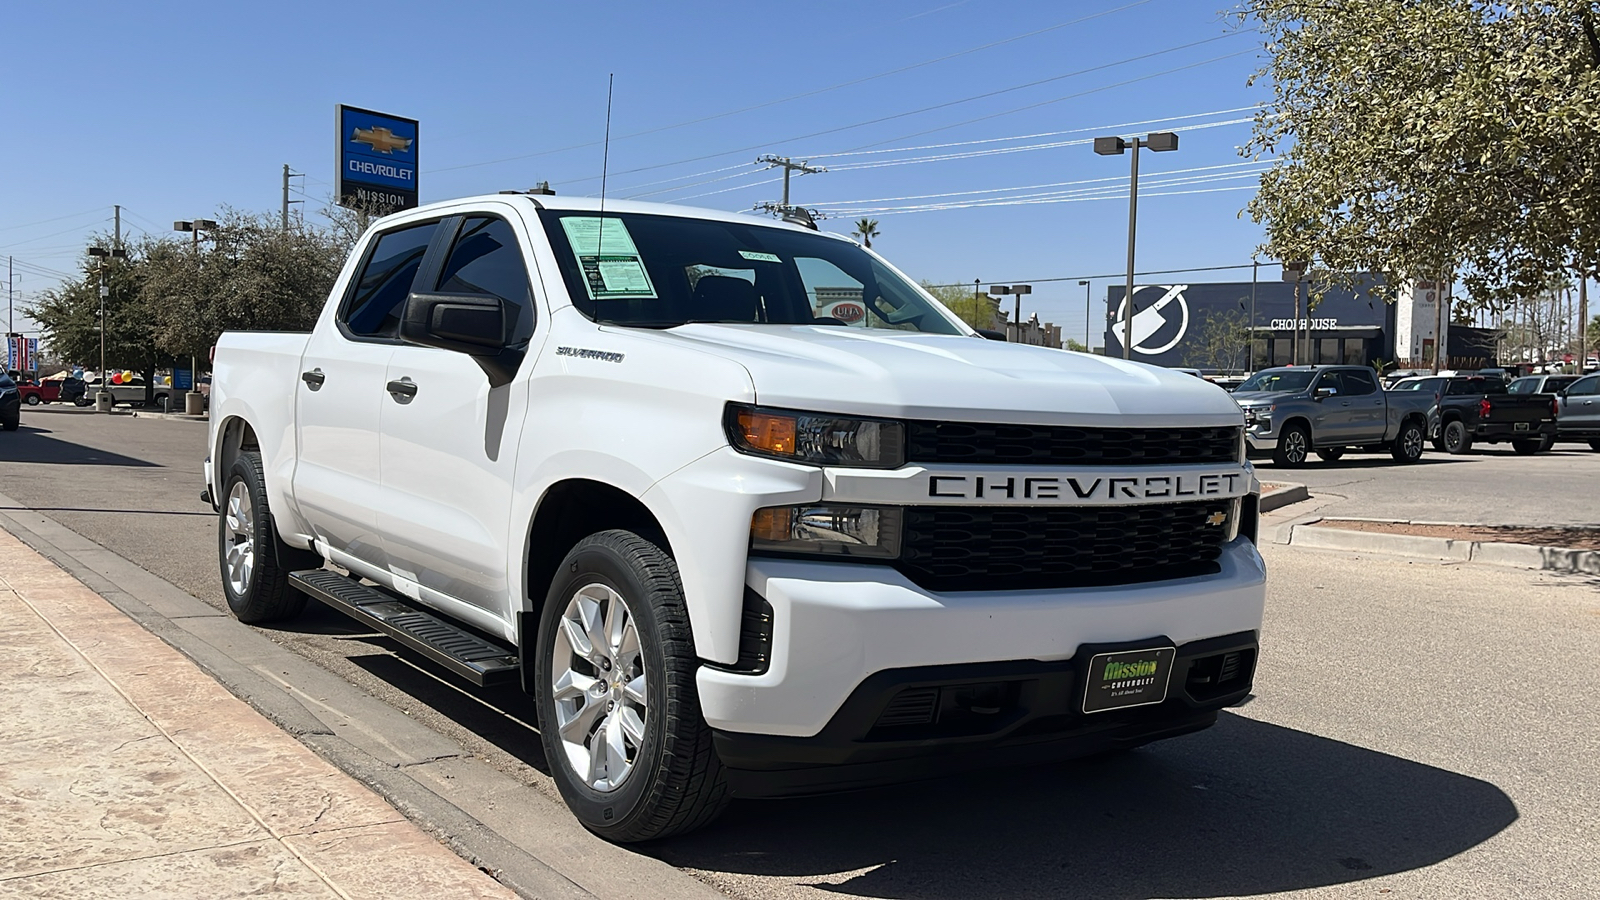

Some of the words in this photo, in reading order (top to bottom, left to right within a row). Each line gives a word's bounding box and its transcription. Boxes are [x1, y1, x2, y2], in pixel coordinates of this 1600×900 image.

[349, 160, 413, 181] CHEVROLET
[357, 188, 405, 206] MISSION
[555, 346, 626, 364] SILVERADO
[928, 473, 1241, 499] CHEVROLET
[1103, 659, 1158, 681] Mission
[1111, 677, 1155, 690] CHEVROLET
